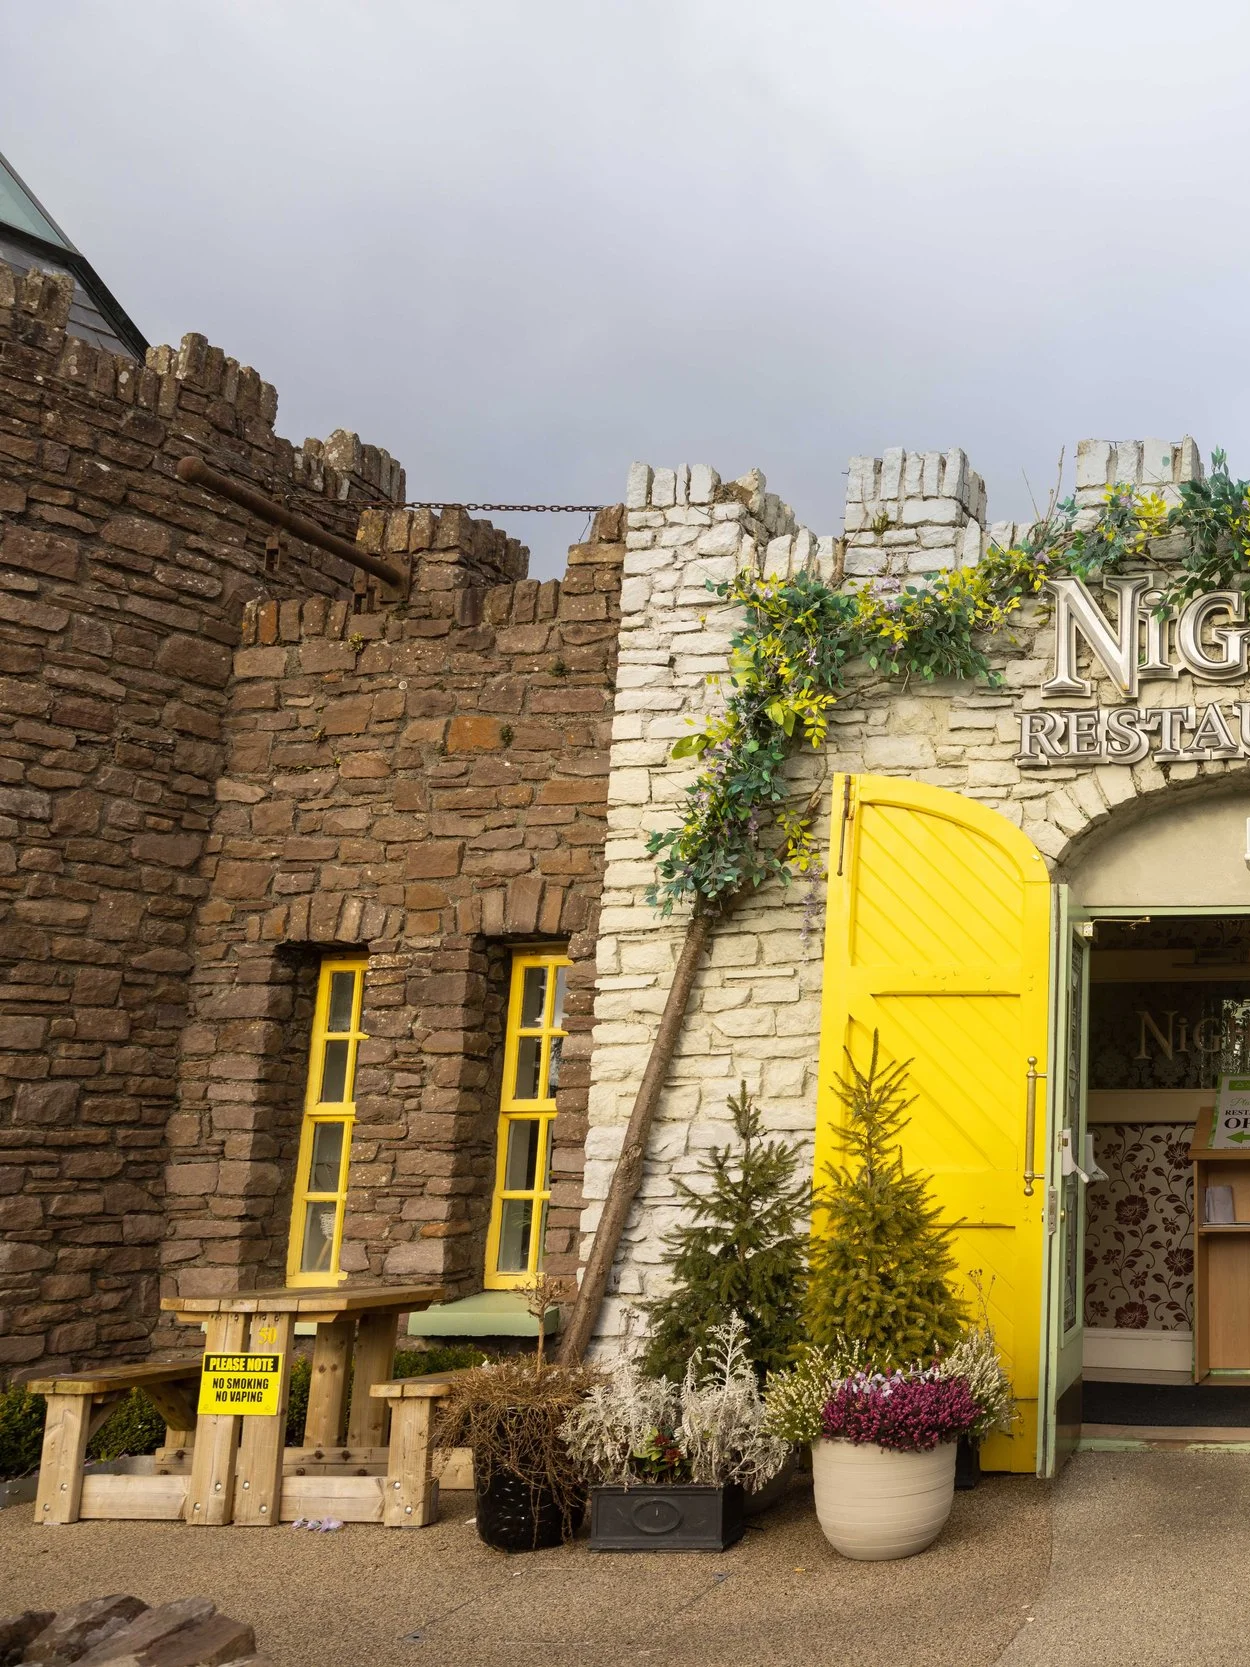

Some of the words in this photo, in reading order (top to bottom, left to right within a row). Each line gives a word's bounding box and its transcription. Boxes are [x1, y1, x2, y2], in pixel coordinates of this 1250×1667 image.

[257, 1327, 277, 1345] 50
[209, 1357, 246, 1371] PLEASE
[246, 1358, 274, 1371] NOTE
[212, 1378, 225, 1389] NO
[226, 1378, 269, 1390] SMOKING
[215, 1391, 228, 1402] NO
[229, 1391, 263, 1403] VAPING
